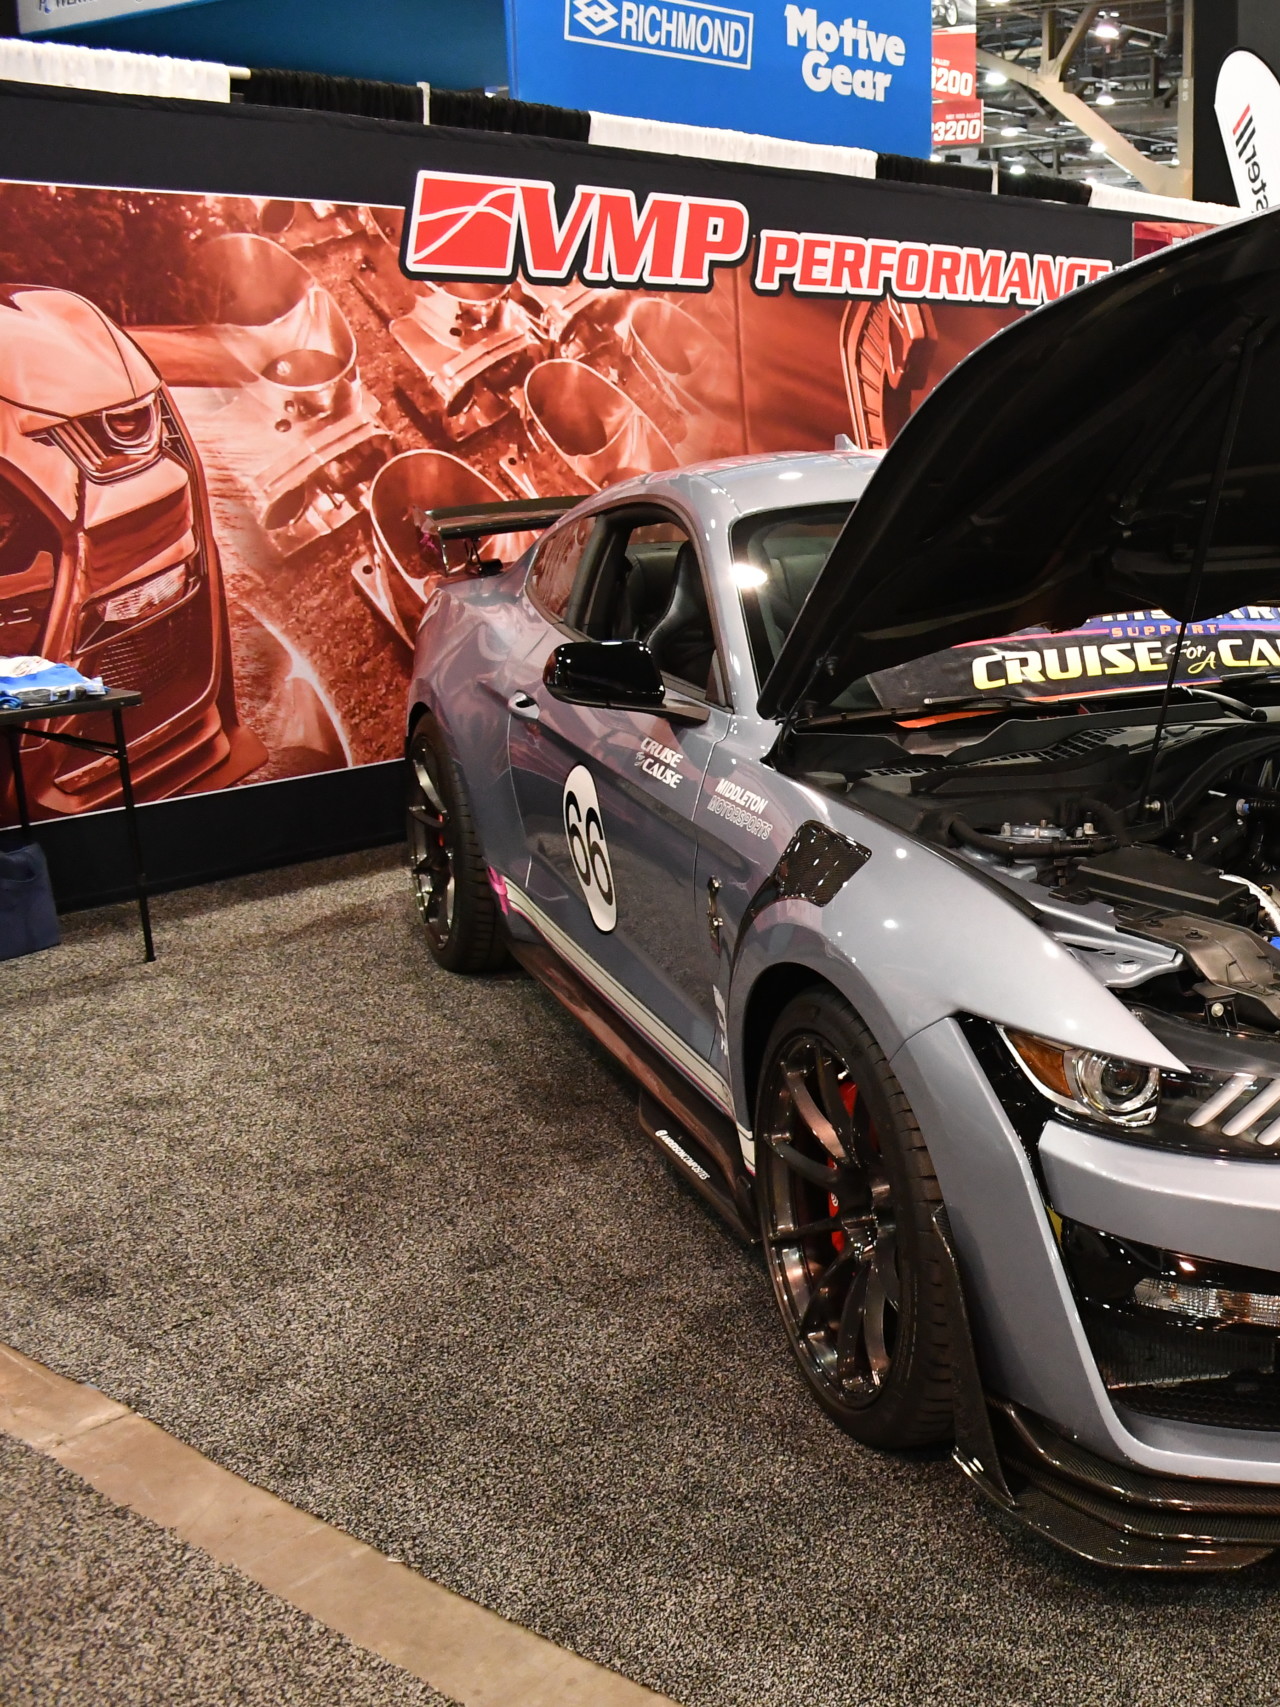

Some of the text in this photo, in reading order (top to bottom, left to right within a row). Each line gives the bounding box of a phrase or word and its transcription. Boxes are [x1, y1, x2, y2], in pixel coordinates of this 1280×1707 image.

[620, 1, 746, 58] RICHMOND
[784, 4, 906, 66] Motive
[801, 50, 892, 102] Gear
[516, 182, 748, 286] VMP
[1111, 623, 1217, 638] SUPPORT
[972, 640, 1169, 690] CRUISE
[640, 736, 684, 768] CRUISE
[642, 758, 684, 789] CAUSE
[707, 795, 773, 840] MOTORSPORTS
[715, 778, 769, 814] MIDDLETON
[565, 790, 614, 906] 66
